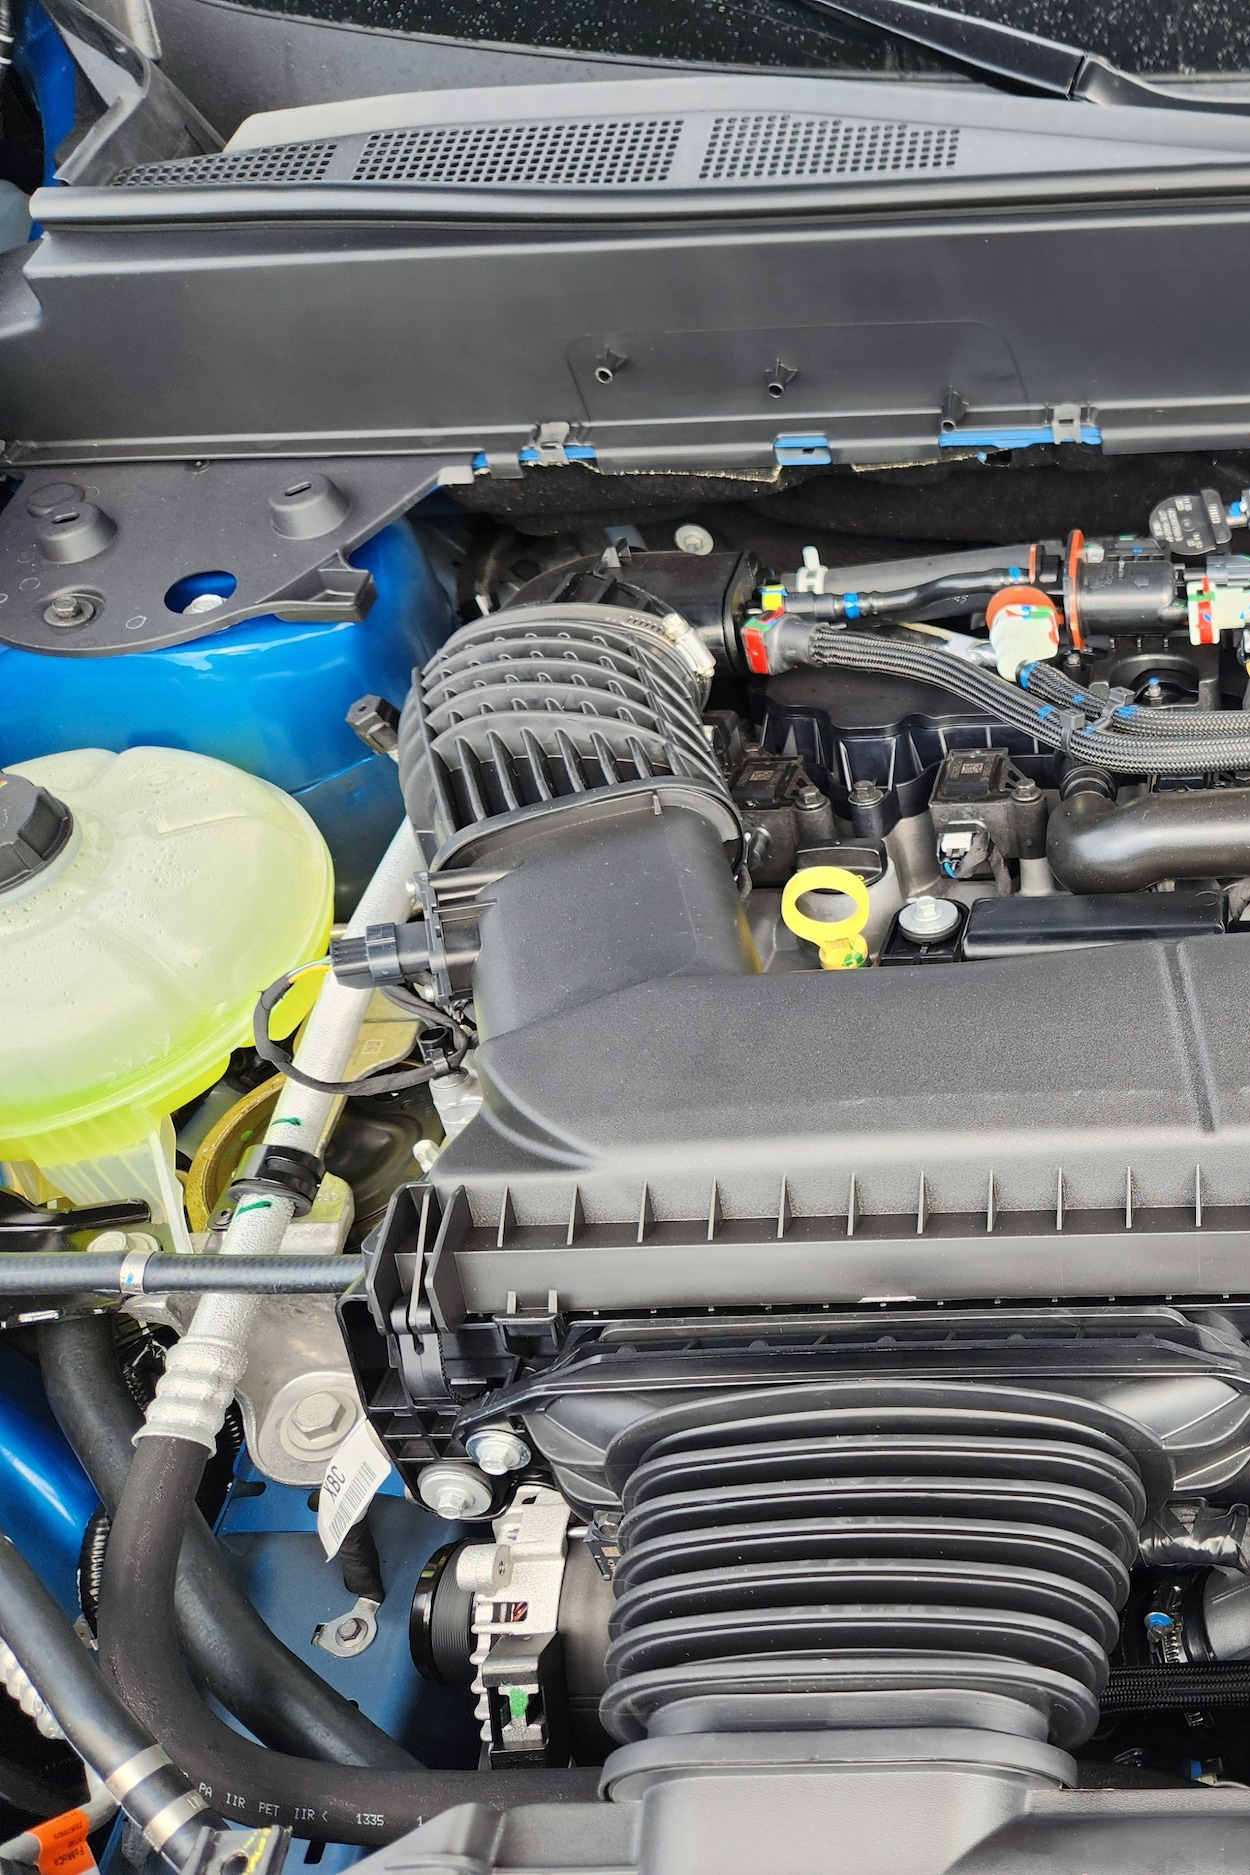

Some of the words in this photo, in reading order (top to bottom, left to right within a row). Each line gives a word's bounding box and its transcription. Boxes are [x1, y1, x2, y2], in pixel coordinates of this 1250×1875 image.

[323, 1465, 346, 1503] XBC
[198, 1782, 213, 1798] PA
[226, 1793, 246, 1809] IIR
[258, 1801, 280, 1817] PET
[356, 1813, 385, 1827] 1335
